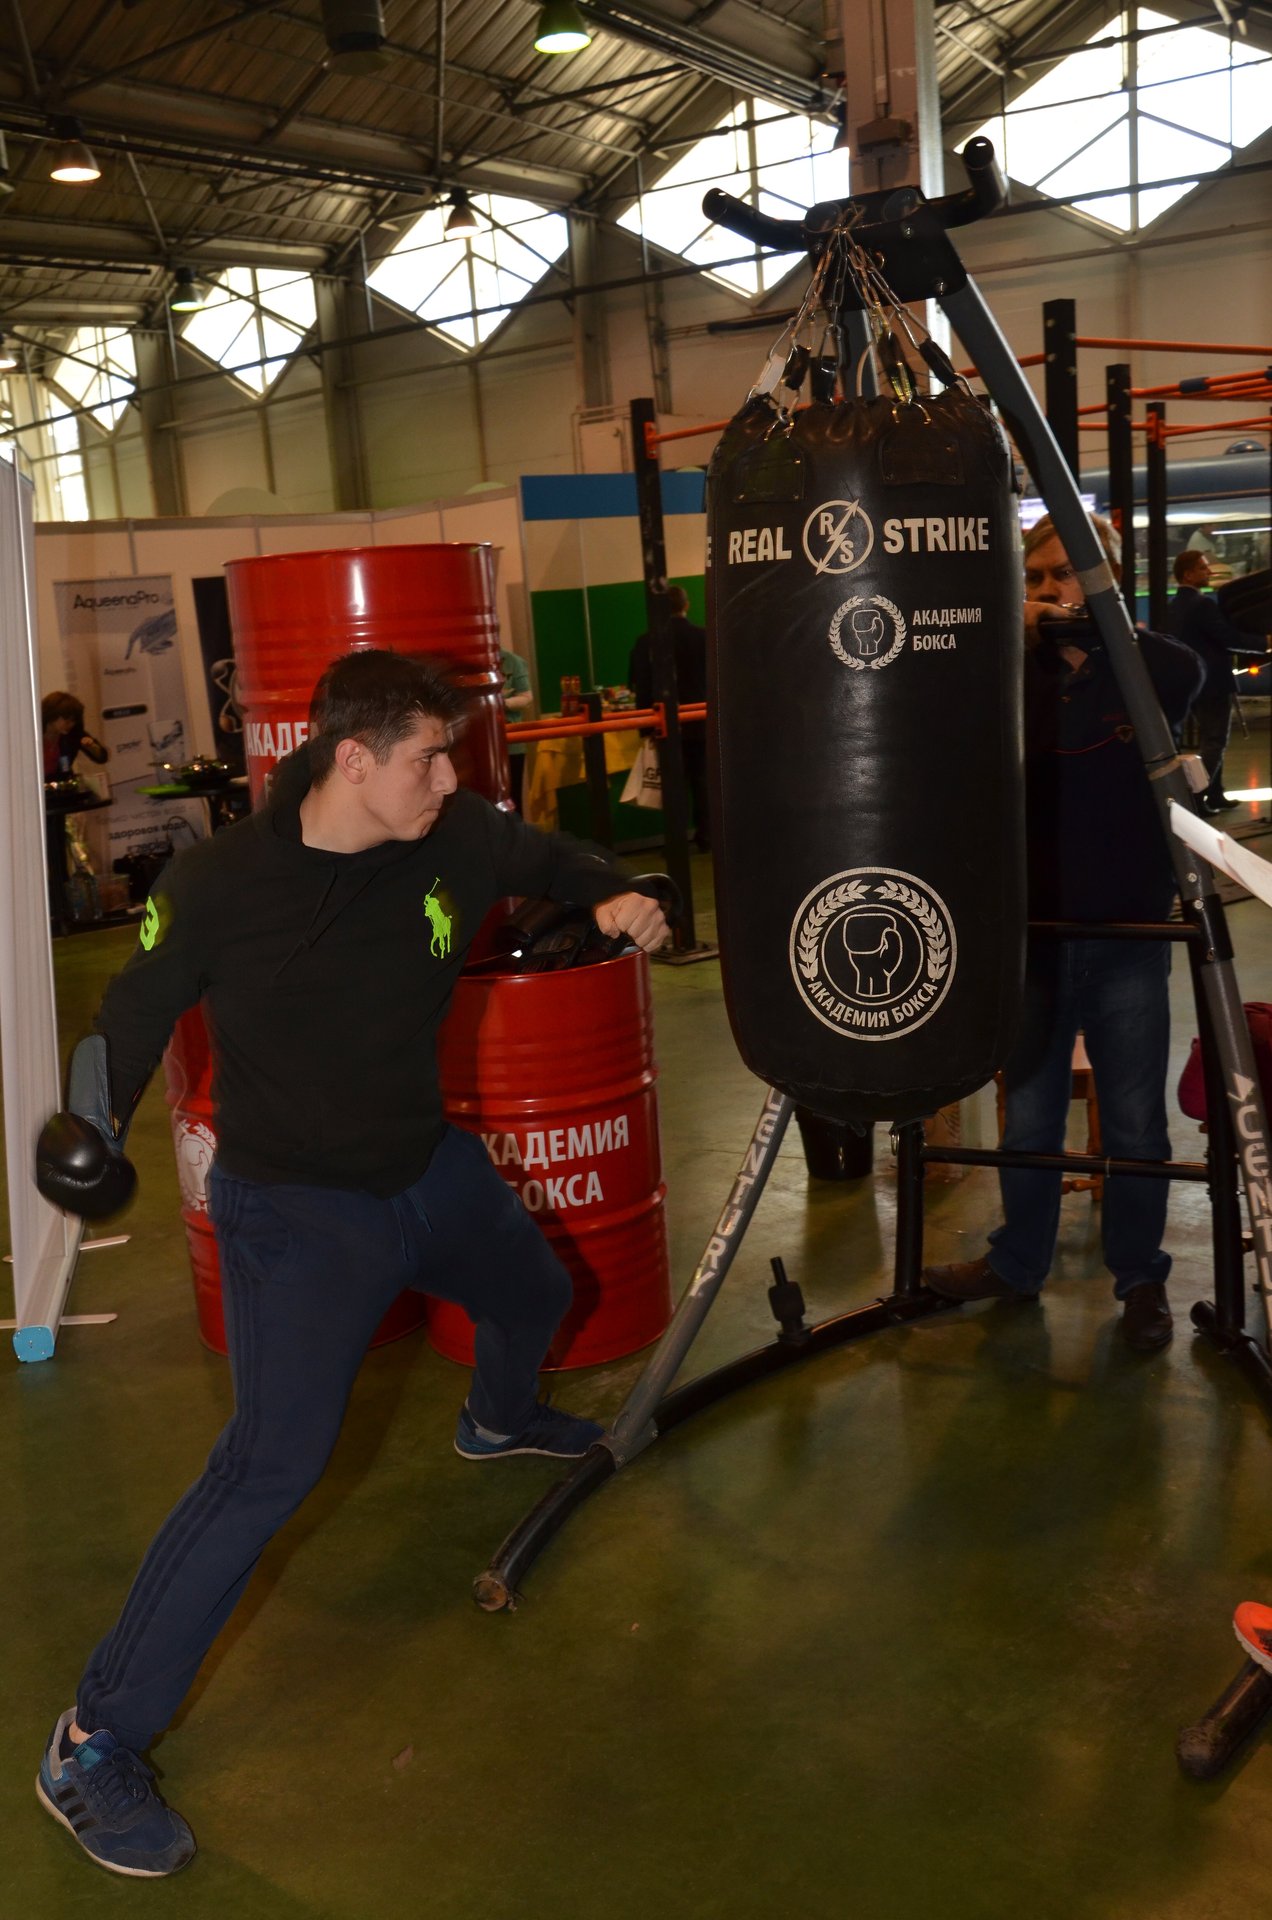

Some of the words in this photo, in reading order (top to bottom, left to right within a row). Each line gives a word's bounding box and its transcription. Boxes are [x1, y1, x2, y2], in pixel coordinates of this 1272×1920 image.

[728, 527, 792, 565] REAL
[883, 516, 990, 554] STRIKE
[912, 607, 983, 628] АКАДЕМИЯ
[912, 634, 957, 651] БОКСА
[245, 721, 309, 764] АКАДЕ
[807, 980, 890, 1028] АКАДЕМИЯ
[891, 982, 939, 1024] БОКСА
[481, 1115, 630, 1171] КАДЕМИЯ
